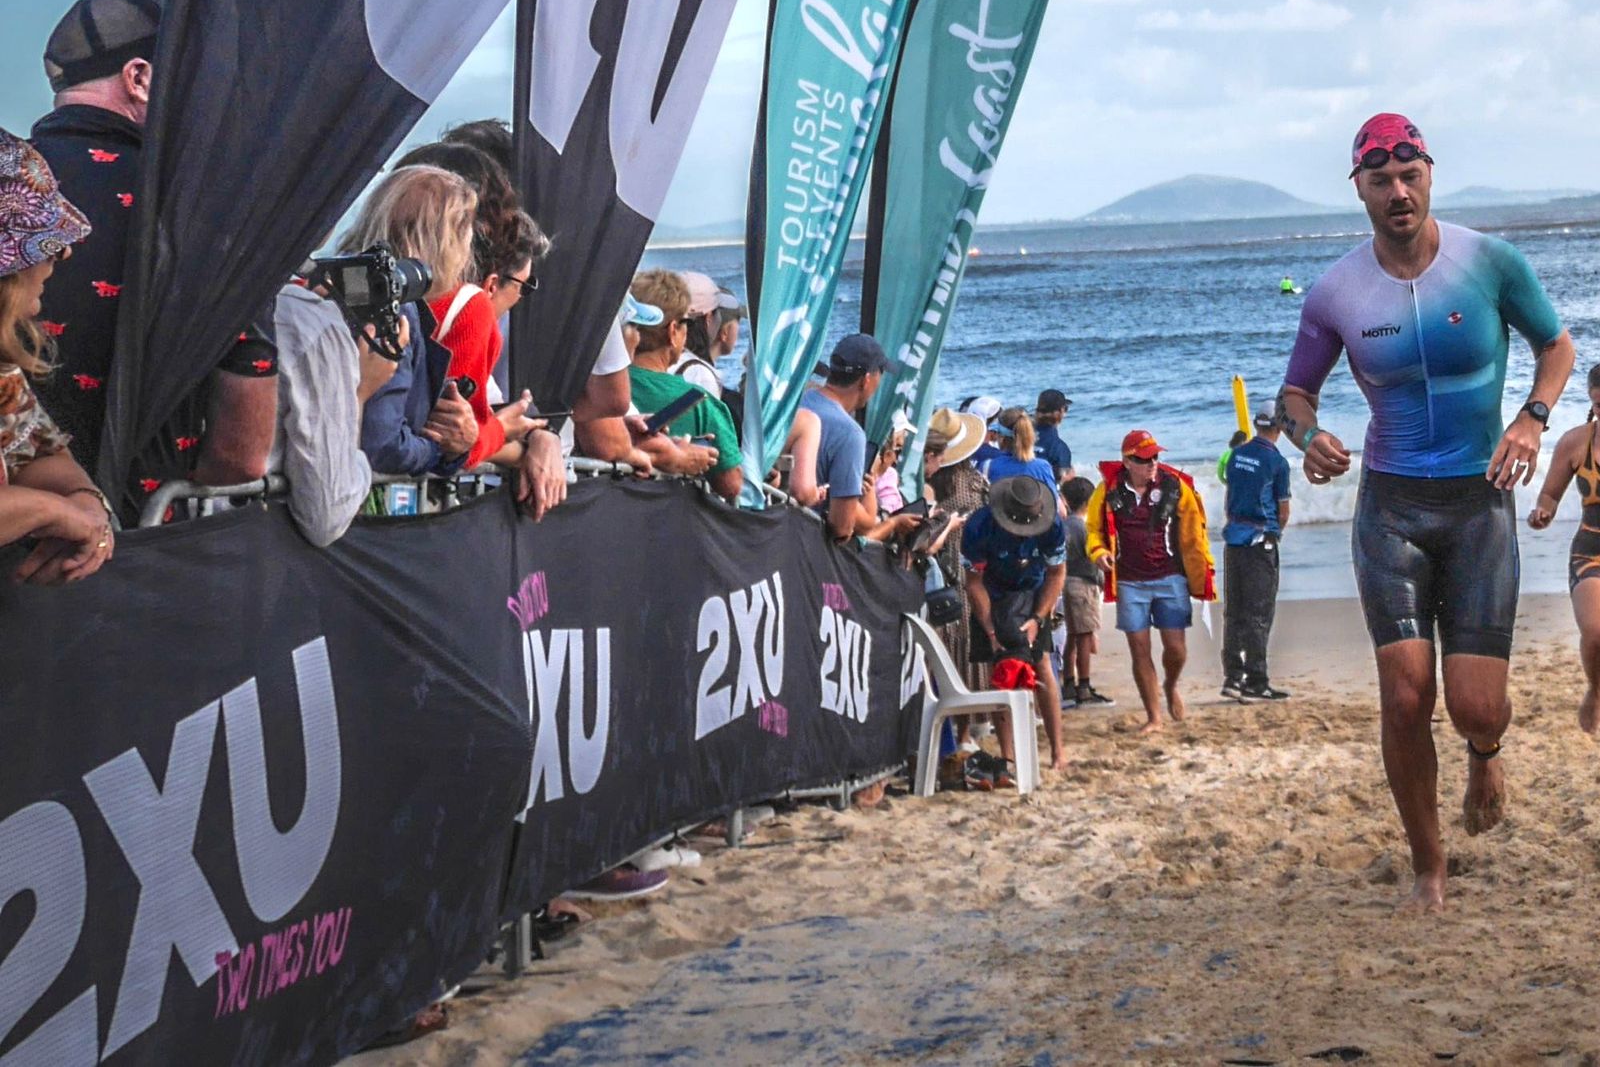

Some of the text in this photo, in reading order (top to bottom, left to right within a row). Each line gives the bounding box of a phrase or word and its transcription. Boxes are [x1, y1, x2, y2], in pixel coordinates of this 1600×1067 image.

[778, 78, 821, 270] TOURISM
[805, 88, 846, 240] EVENTS
[1361, 325, 1401, 339] MOTTIV
[514, 627, 611, 824] XU
[695, 571, 784, 741] 2XU
[820, 605, 871, 724] 2XU
[214, 907, 352, 1019] TWO TIMES YOU
